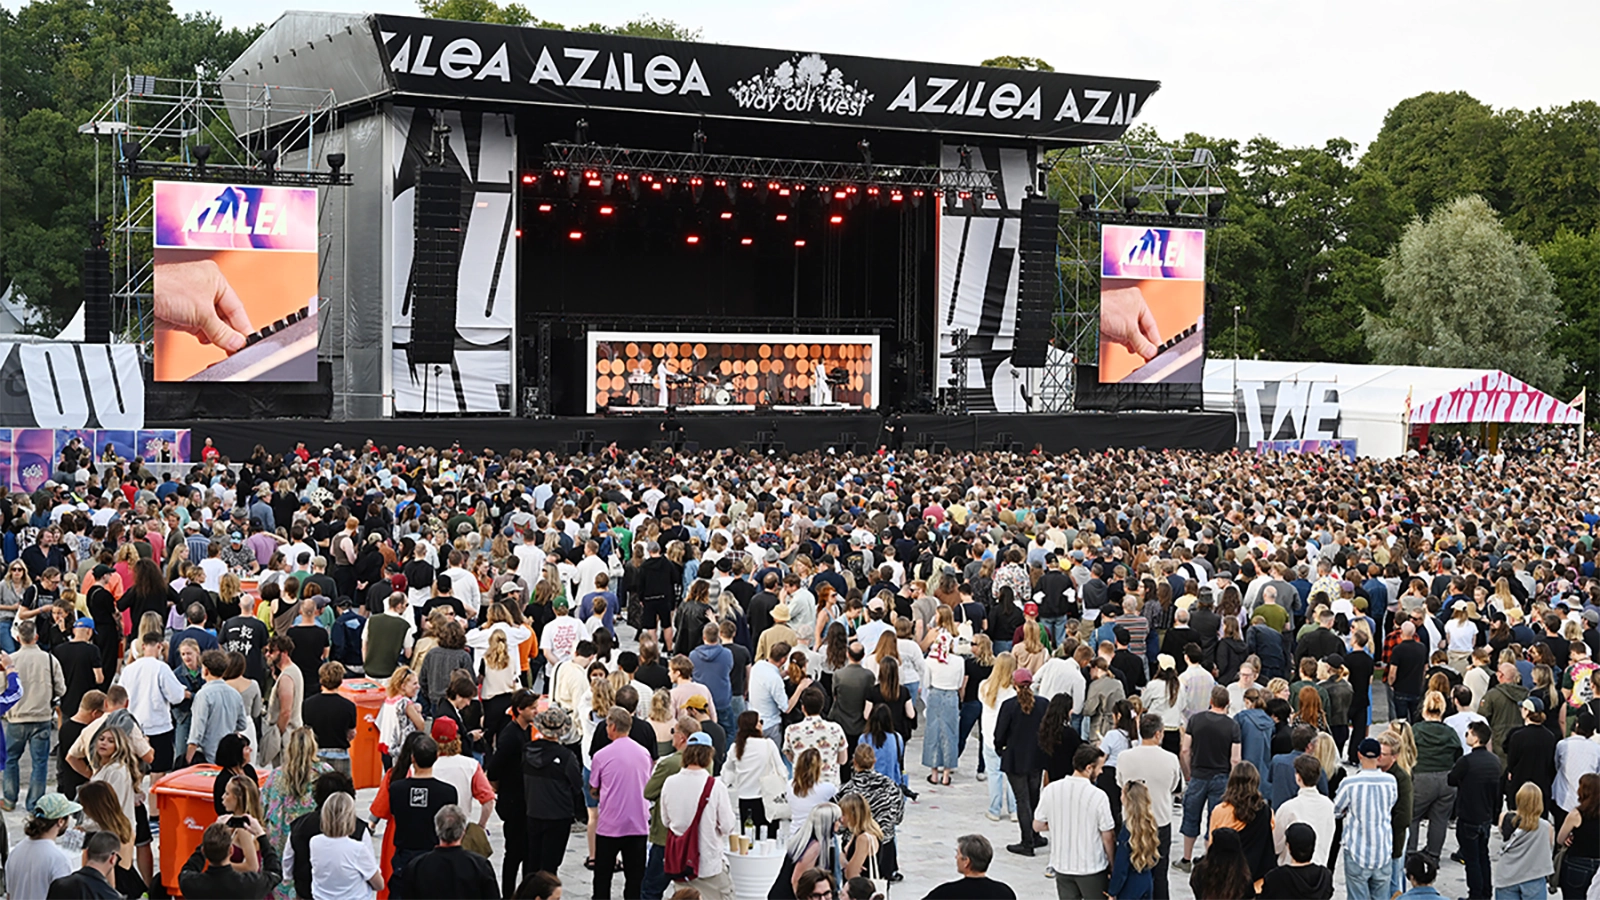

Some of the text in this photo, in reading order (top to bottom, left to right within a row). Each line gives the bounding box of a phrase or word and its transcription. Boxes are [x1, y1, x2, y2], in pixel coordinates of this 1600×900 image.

[181, 200, 288, 235] AZALEA
[1118, 240, 1185, 267] AZALEA
[1435, 392, 1473, 423] BAR
[1473, 392, 1511, 422] BAR
[1510, 392, 1554, 423] BAR
